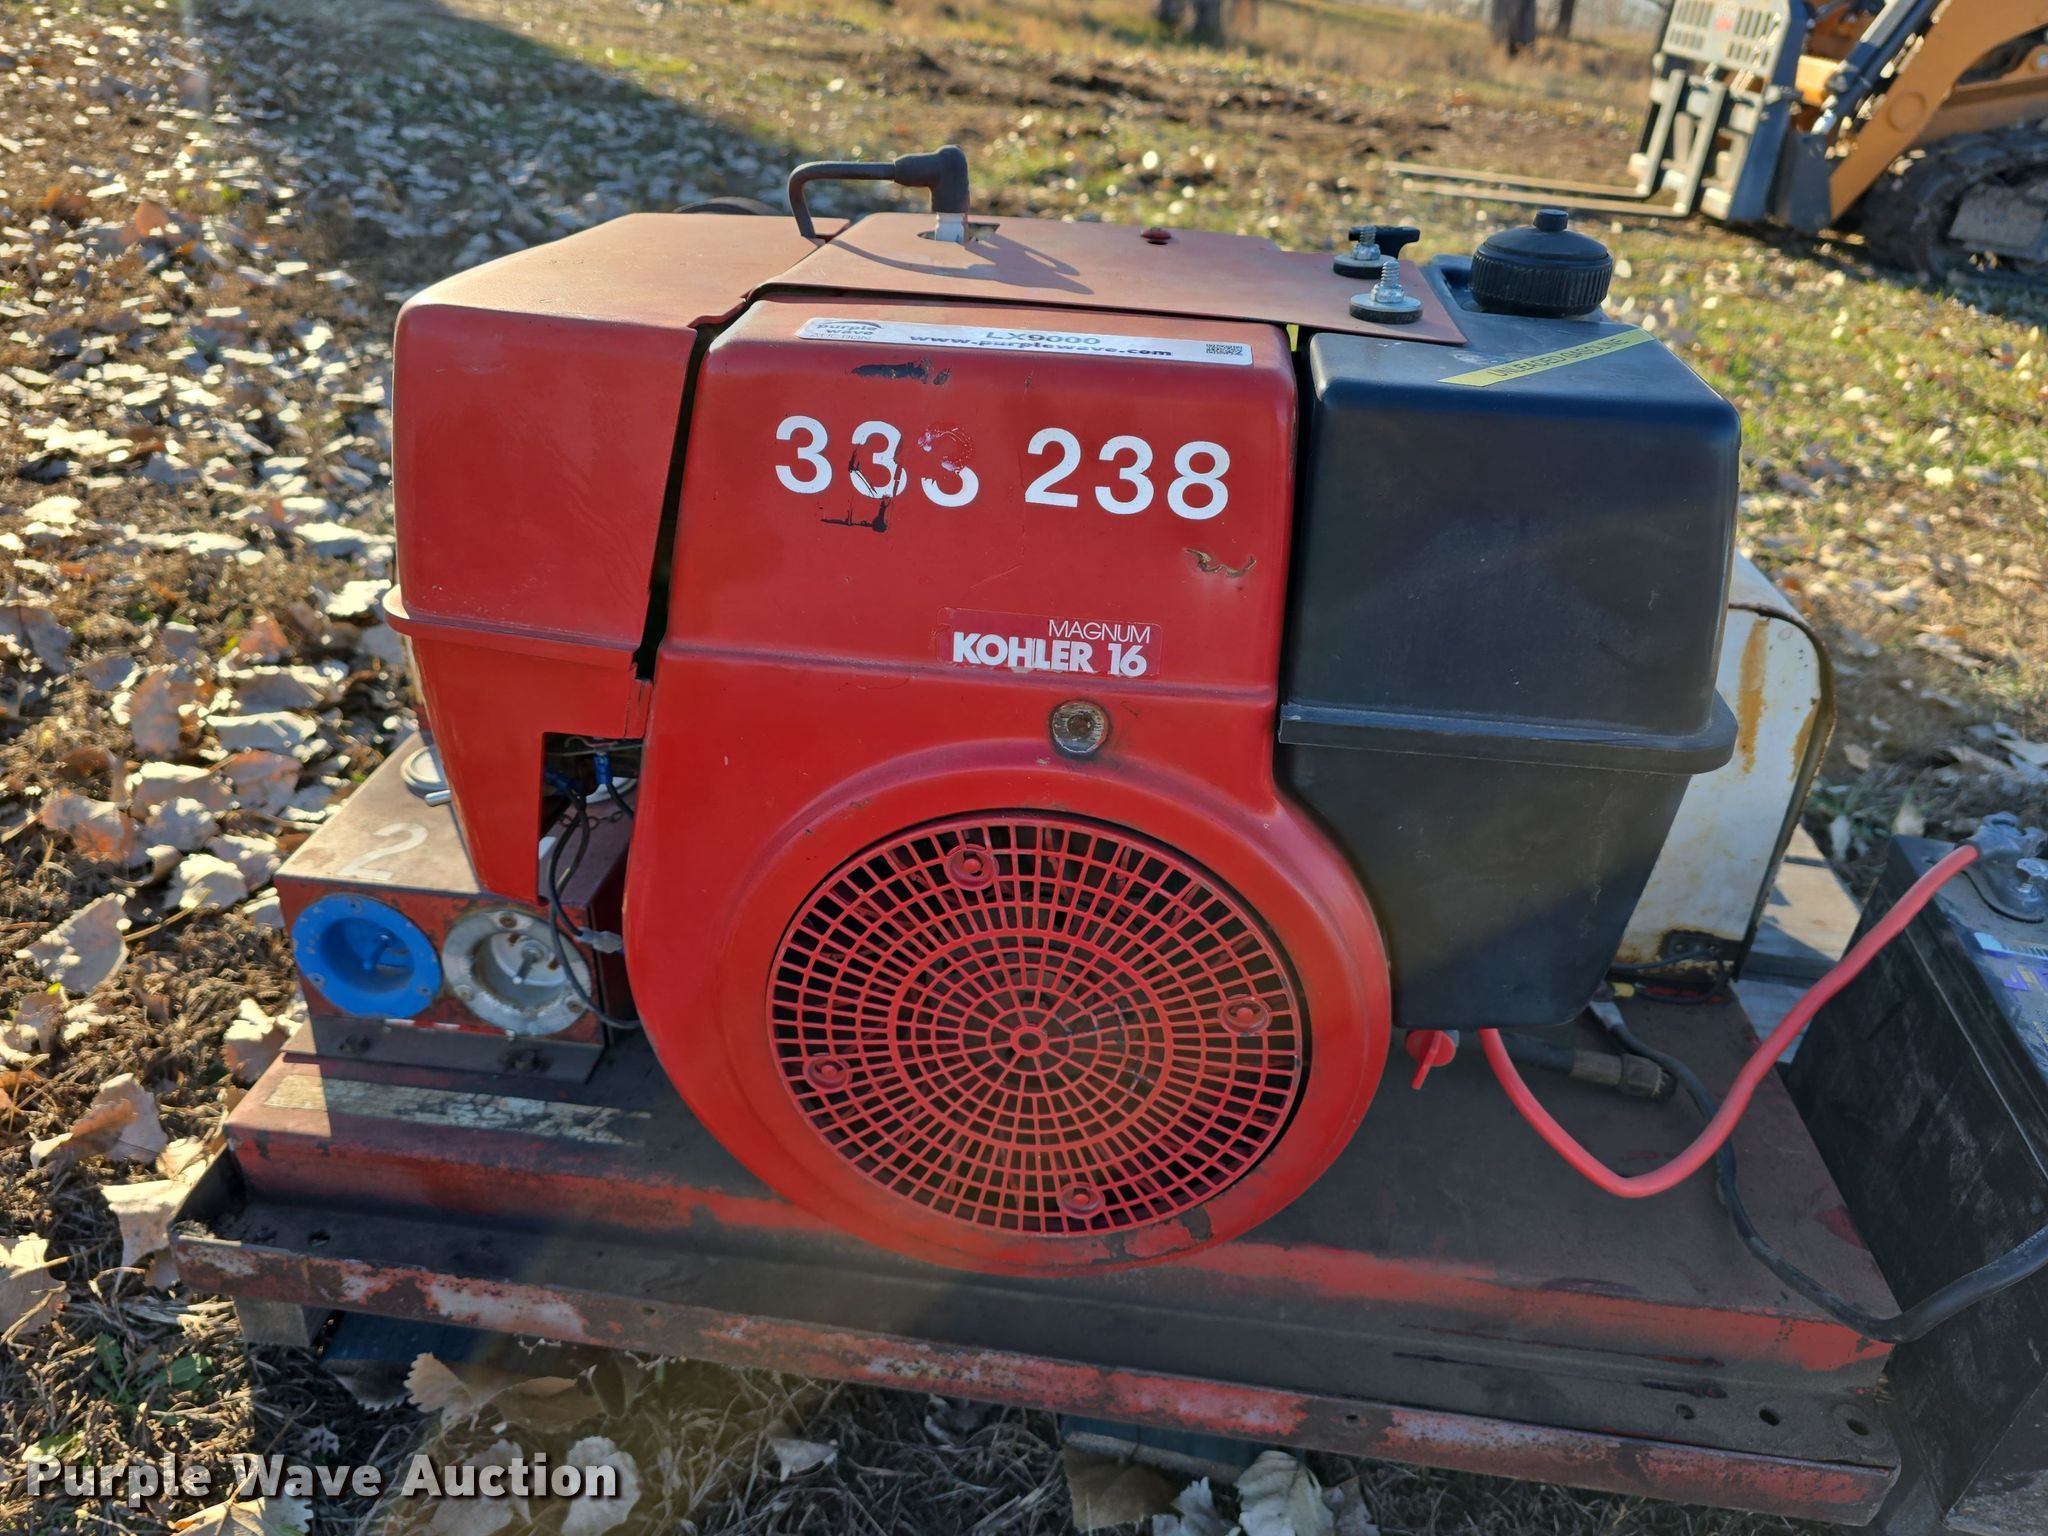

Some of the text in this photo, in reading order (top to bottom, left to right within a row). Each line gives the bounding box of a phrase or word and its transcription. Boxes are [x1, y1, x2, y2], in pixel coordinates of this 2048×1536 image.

[910, 335, 1172, 356] www.purplewave.com
[985, 331, 1101, 345] LX9000
[1024, 427, 1231, 520] 238
[1049, 619, 1150, 644] MAGNUM
[953, 631, 1147, 678] KOHLER 16
[336, 822, 429, 881] 2
